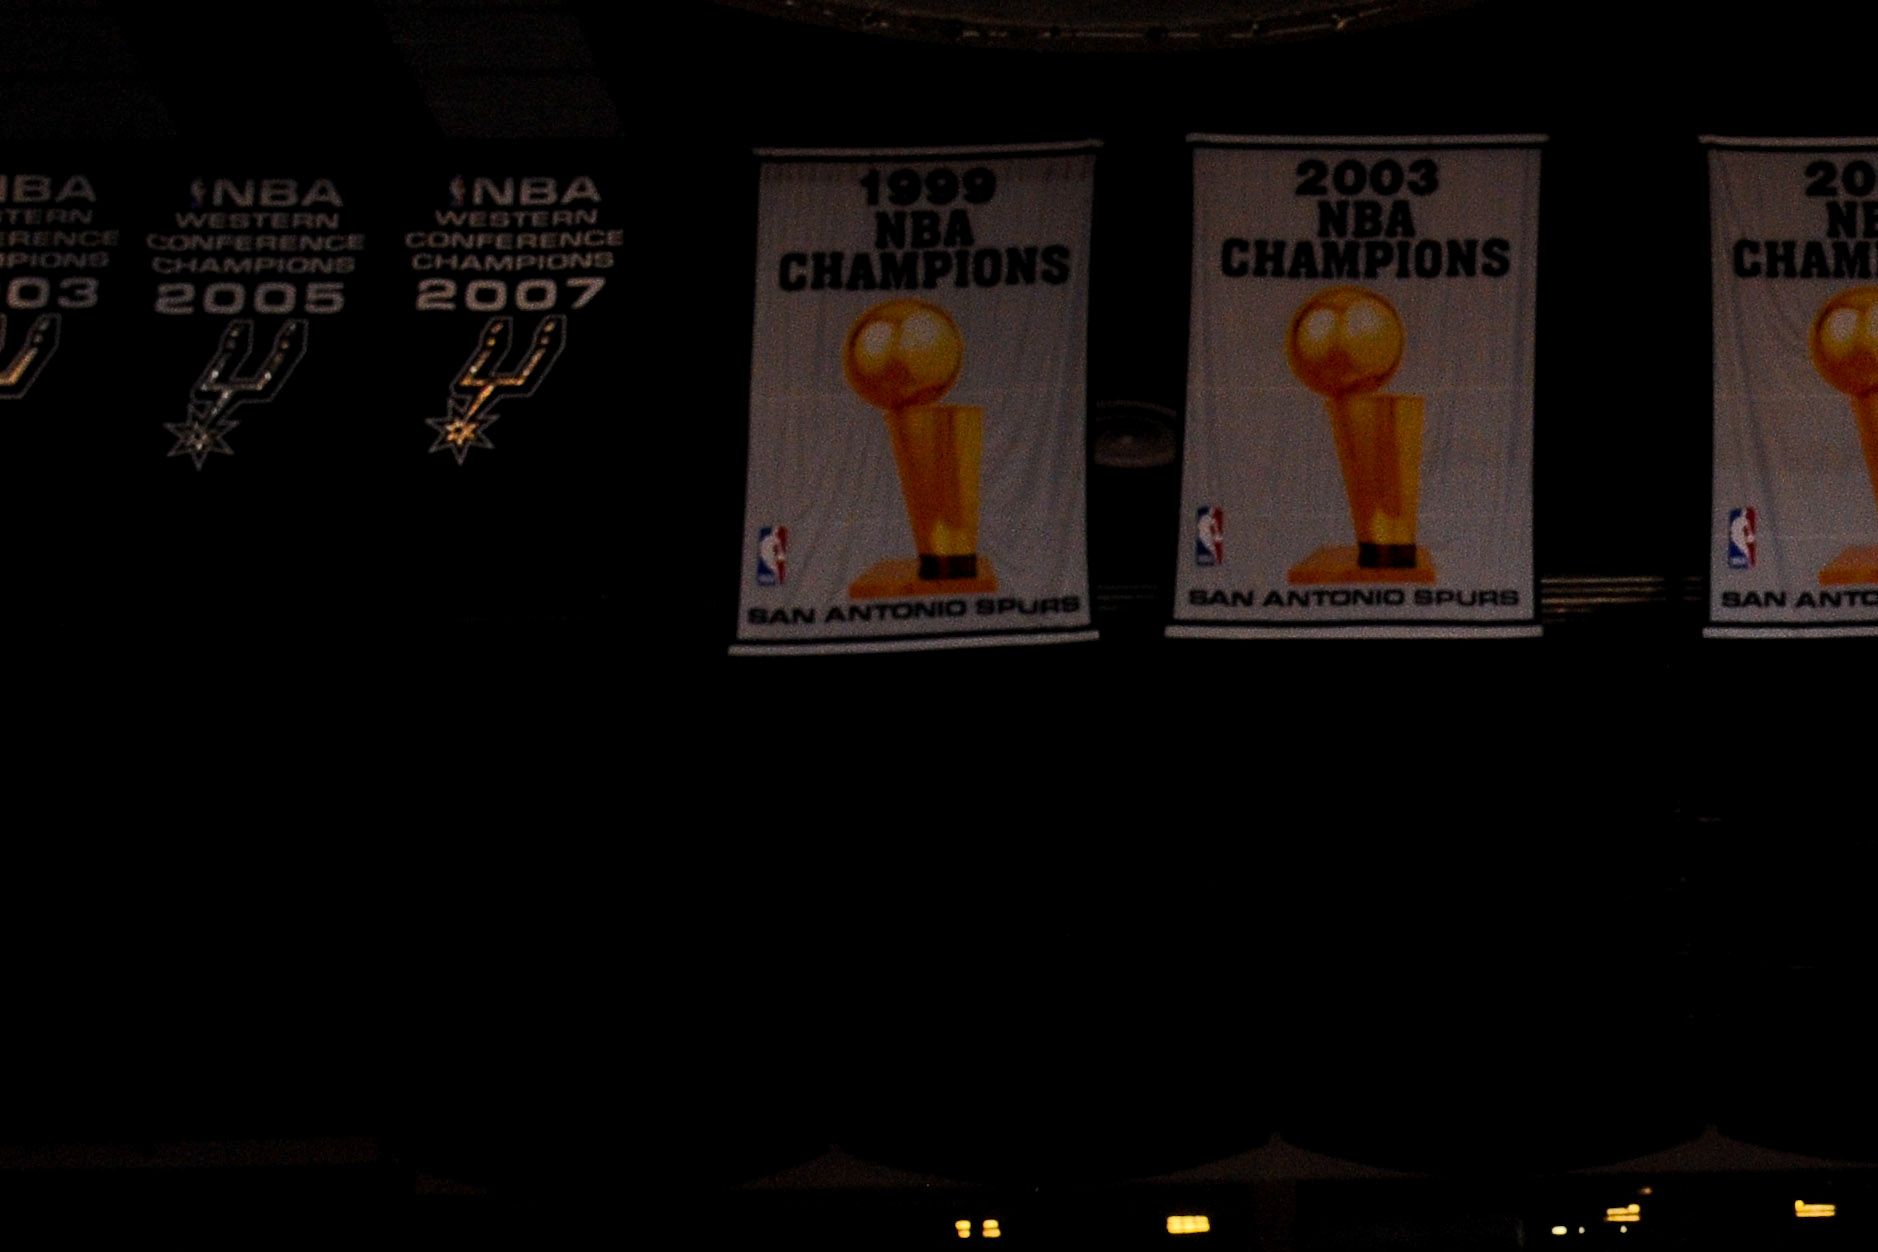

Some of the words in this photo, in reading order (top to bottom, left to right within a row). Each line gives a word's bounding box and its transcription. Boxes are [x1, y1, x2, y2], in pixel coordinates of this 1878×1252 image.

[0, 174, 96, 203] BA
[472, 176, 601, 206] NBA
[859, 166, 997, 207] 1999
[1295, 157, 1439, 197] 2003
[212, 178, 343, 208] NBA
[0, 207, 93, 225] TERN
[175, 212, 339, 230] WESTERN
[435, 208, 598, 228] WESTERN
[874, 208, 975, 248] NBA
[1317, 199, 1416, 239] NBA
[146, 233, 363, 252] CONFERENCE
[405, 229, 623, 250] CONFERENCE
[0, 251, 110, 269] PIONS
[152, 256, 355, 275] CHAMPIONS
[411, 251, 615, 272] CHAMPIONS
[778, 242, 1071, 293] CHAMPIONS
[1220, 235, 1511, 280] CHAMPIONS
[154, 281, 345, 315] 2005
[416, 276, 606, 312] 2007
[747, 607, 816, 625] SAN
[824, 599, 968, 623] ANTONIO
[975, 596, 1081, 616] SPURS
[1188, 589, 1254, 608] SAN
[1262, 588, 1405, 608] ANTONIO
[1414, 589, 1520, 607] SPURS
[1721, 591, 1787, 608] SAN
